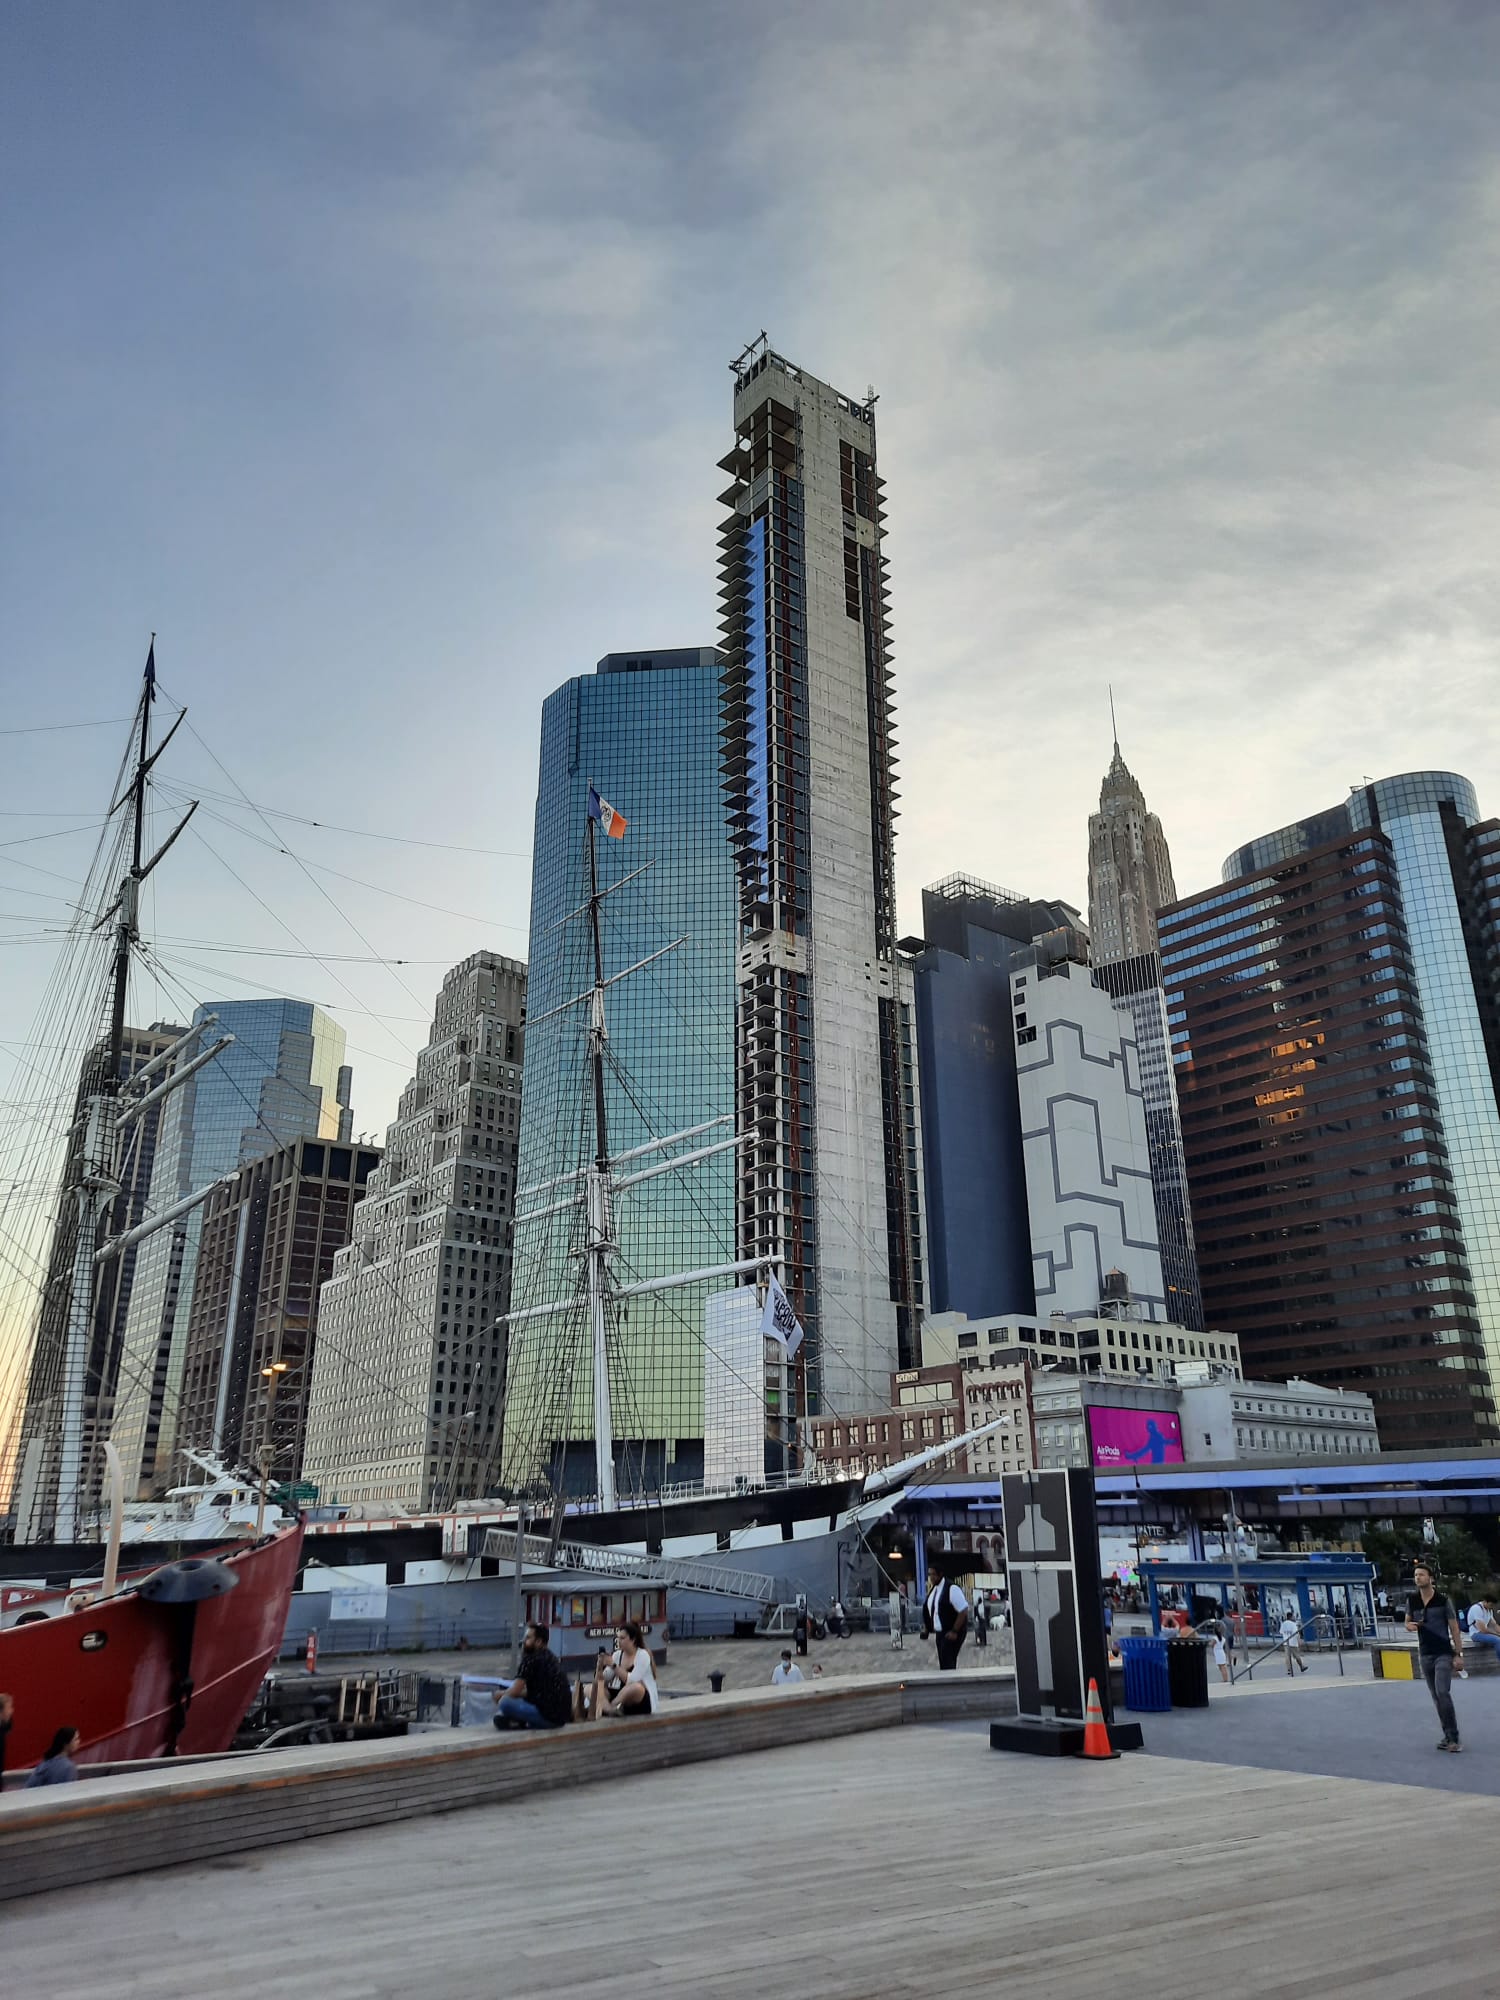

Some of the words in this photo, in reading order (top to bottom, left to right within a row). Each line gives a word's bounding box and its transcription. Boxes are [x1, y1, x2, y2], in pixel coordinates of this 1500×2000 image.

[1097, 1446, 1120, 1456] AirPods
[590, 1628, 601, 1637] NEW
[602, 1627, 614, 1636] YORK
